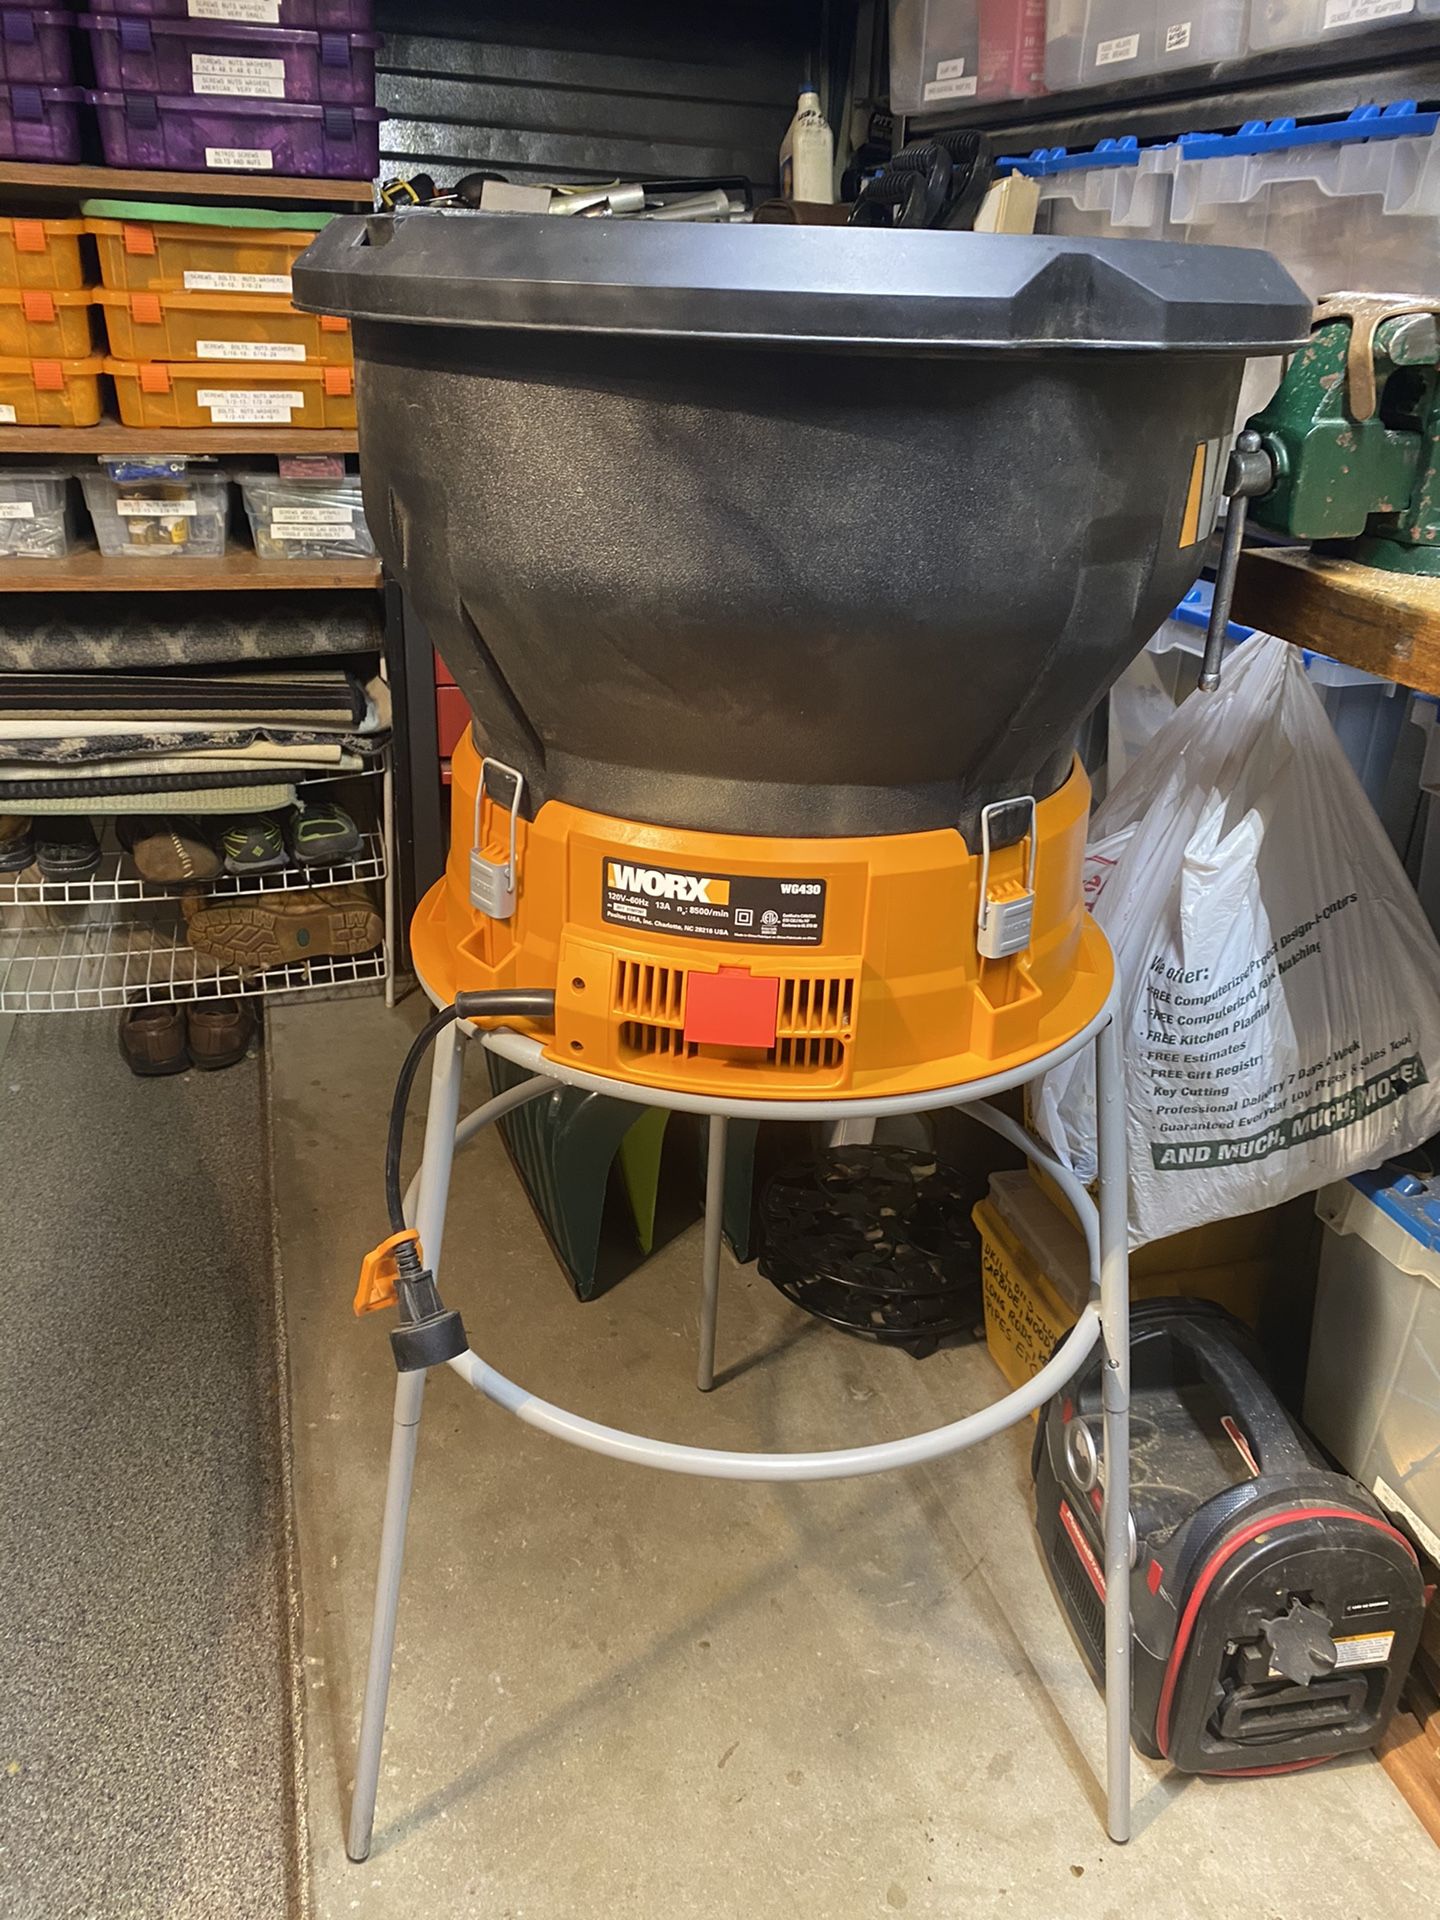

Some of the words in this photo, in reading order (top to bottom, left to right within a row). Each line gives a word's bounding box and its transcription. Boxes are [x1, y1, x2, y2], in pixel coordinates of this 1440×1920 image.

[612, 863, 712, 904] WORX
[780, 883, 821, 896] WG430
[655, 901, 671, 911] 13A
[689, 905, 729, 918] 8500/min
[714, 928, 729, 937] USA
[1150, 954, 1166, 975] We
[1149, 985, 1172, 1005] FREE
[1146, 1029, 1177, 1046] FREE
[1179, 1026, 1229, 1046] Kitchen
[1231, 1001, 1271, 1034] Plannin
[1148, 1008, 1174, 1025] FREE
[1146, 1050, 1180, 1064] FREE
[1183, 1040, 1247, 1064] Estimates
[1150, 1068, 1183, 1080] FREE
[1187, 1068, 1212, 1080] Gift
[1153, 1085, 1177, 1098] Key
[1180, 1085, 1230, 1099] Cutting
[1155, 1100, 1238, 1116] Professional
[1288, 1074, 1296, 1085] 7
[1159, 1120, 1234, 1133] Guaranteed
[1160, 1146, 1212, 1166] AND
[1217, 1128, 1287, 1162] MUCH,
[983, 1257, 1020, 1309] CARBIDE
